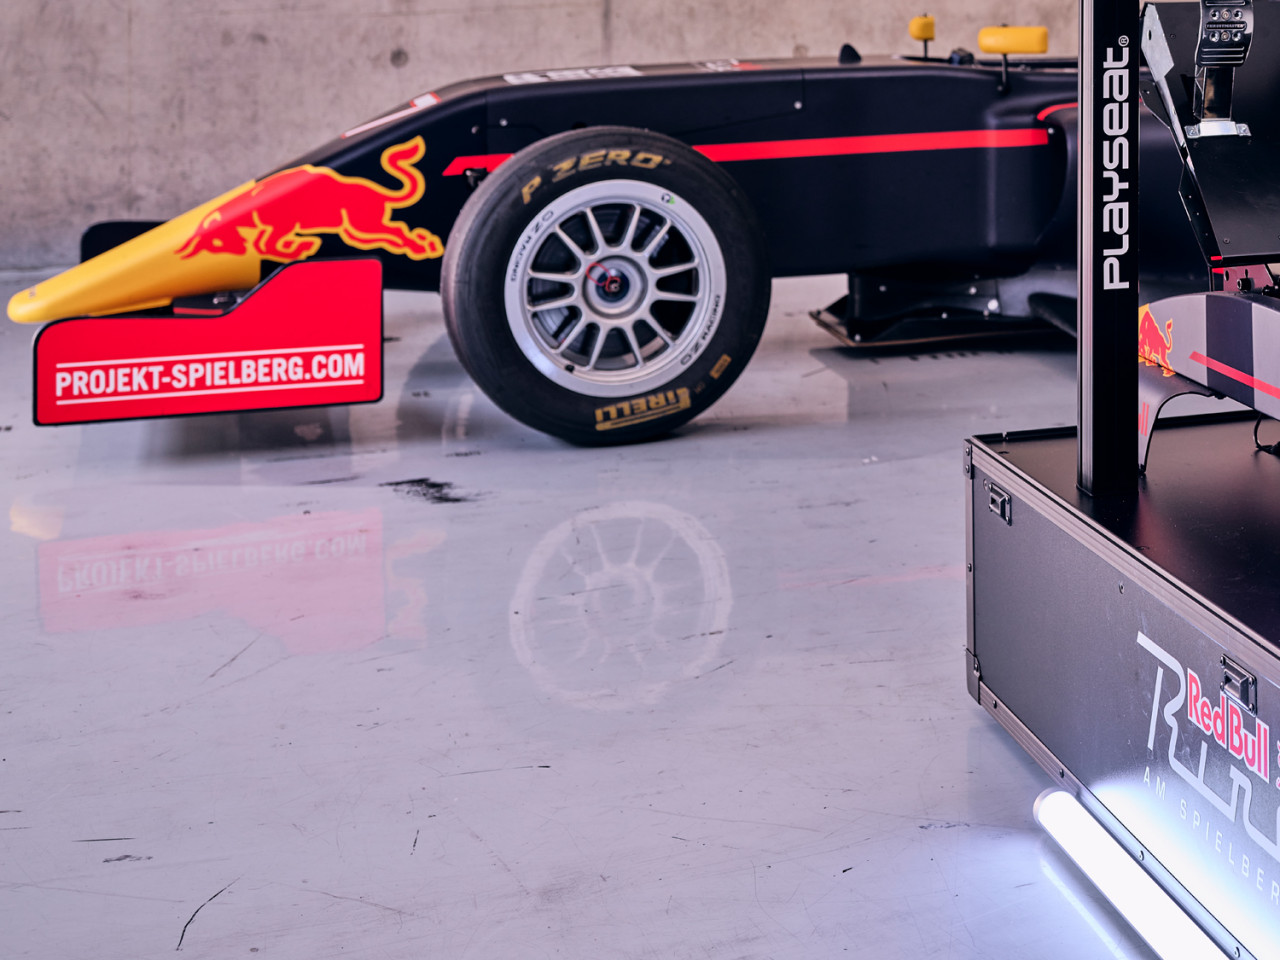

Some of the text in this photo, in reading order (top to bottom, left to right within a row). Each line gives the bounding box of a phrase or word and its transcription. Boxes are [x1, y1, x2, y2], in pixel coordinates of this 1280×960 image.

[521, 148, 665, 205] P ZERO
[55, 352, 366, 398] PROJEKT-SPIELBERG.COM
[594, 386, 691, 431] PIRELLI
[1187, 667, 1270, 784] Red Bull
[1143, 765, 1167, 801] AM
